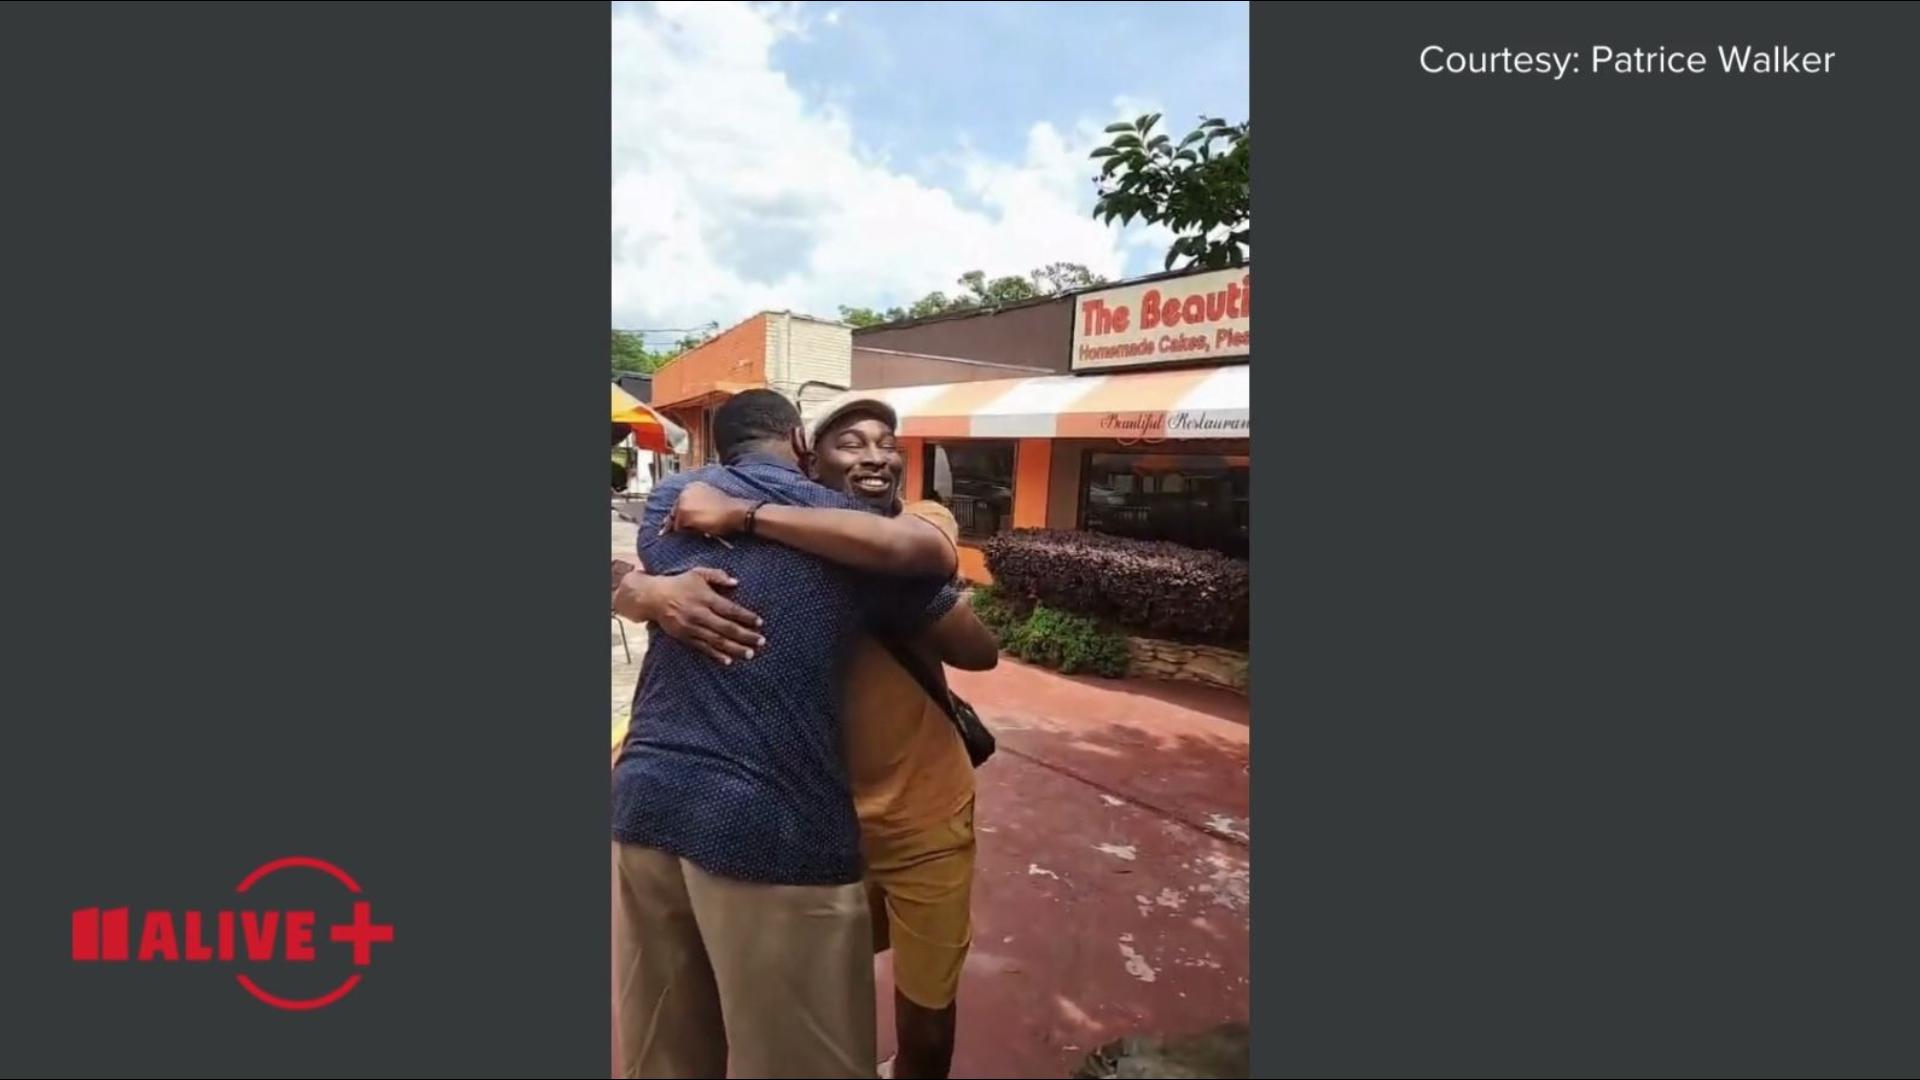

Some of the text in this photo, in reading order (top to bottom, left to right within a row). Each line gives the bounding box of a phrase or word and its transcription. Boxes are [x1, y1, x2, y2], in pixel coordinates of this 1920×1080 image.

[1082, 300, 1130, 336] The
[1080, 339, 1155, 361] Homemade
[1158, 332, 1210, 353] Cakes,
[1101, 413, 1163, 434] Beautiful
